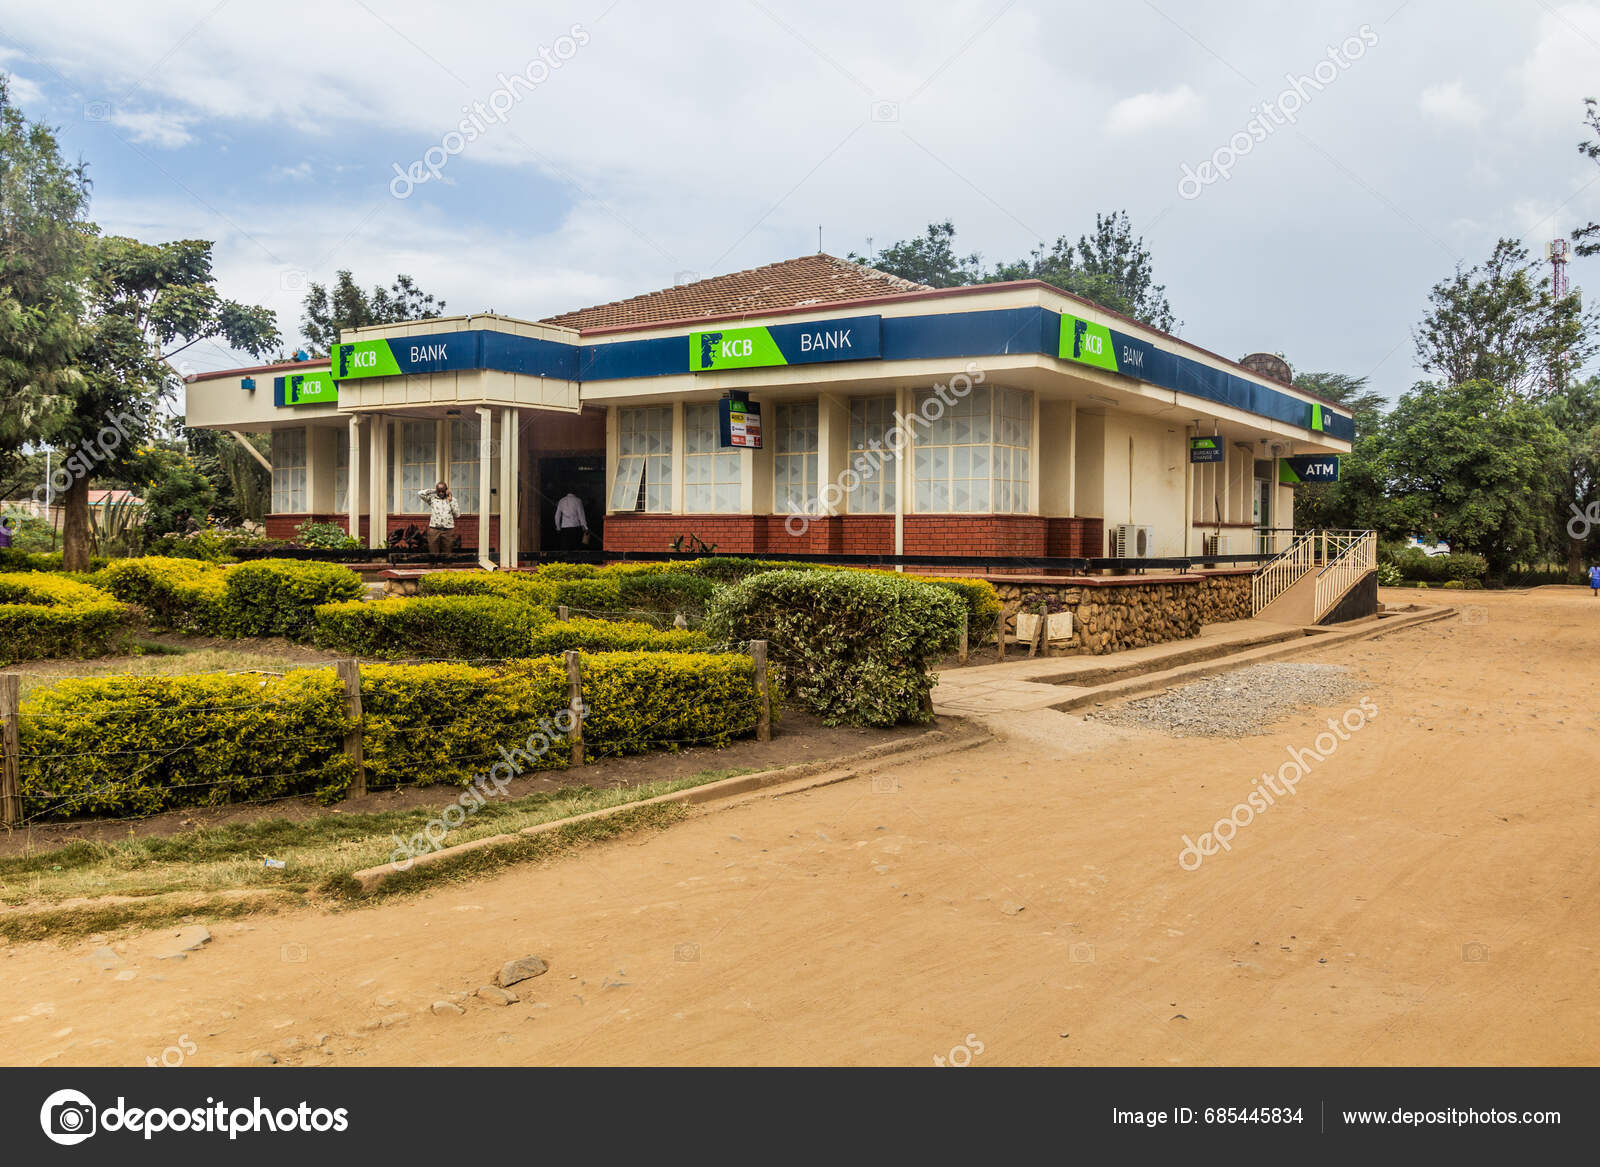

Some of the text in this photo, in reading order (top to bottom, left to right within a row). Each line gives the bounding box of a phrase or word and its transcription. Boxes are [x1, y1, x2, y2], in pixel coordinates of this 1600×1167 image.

[354, 343, 448, 368] KCB BANK
[721, 329, 852, 358] KCB BANK
[1085, 333, 1144, 368] KCB BANK
[303, 380, 321, 395] KCB
[1305, 463, 1334, 475] ATM
